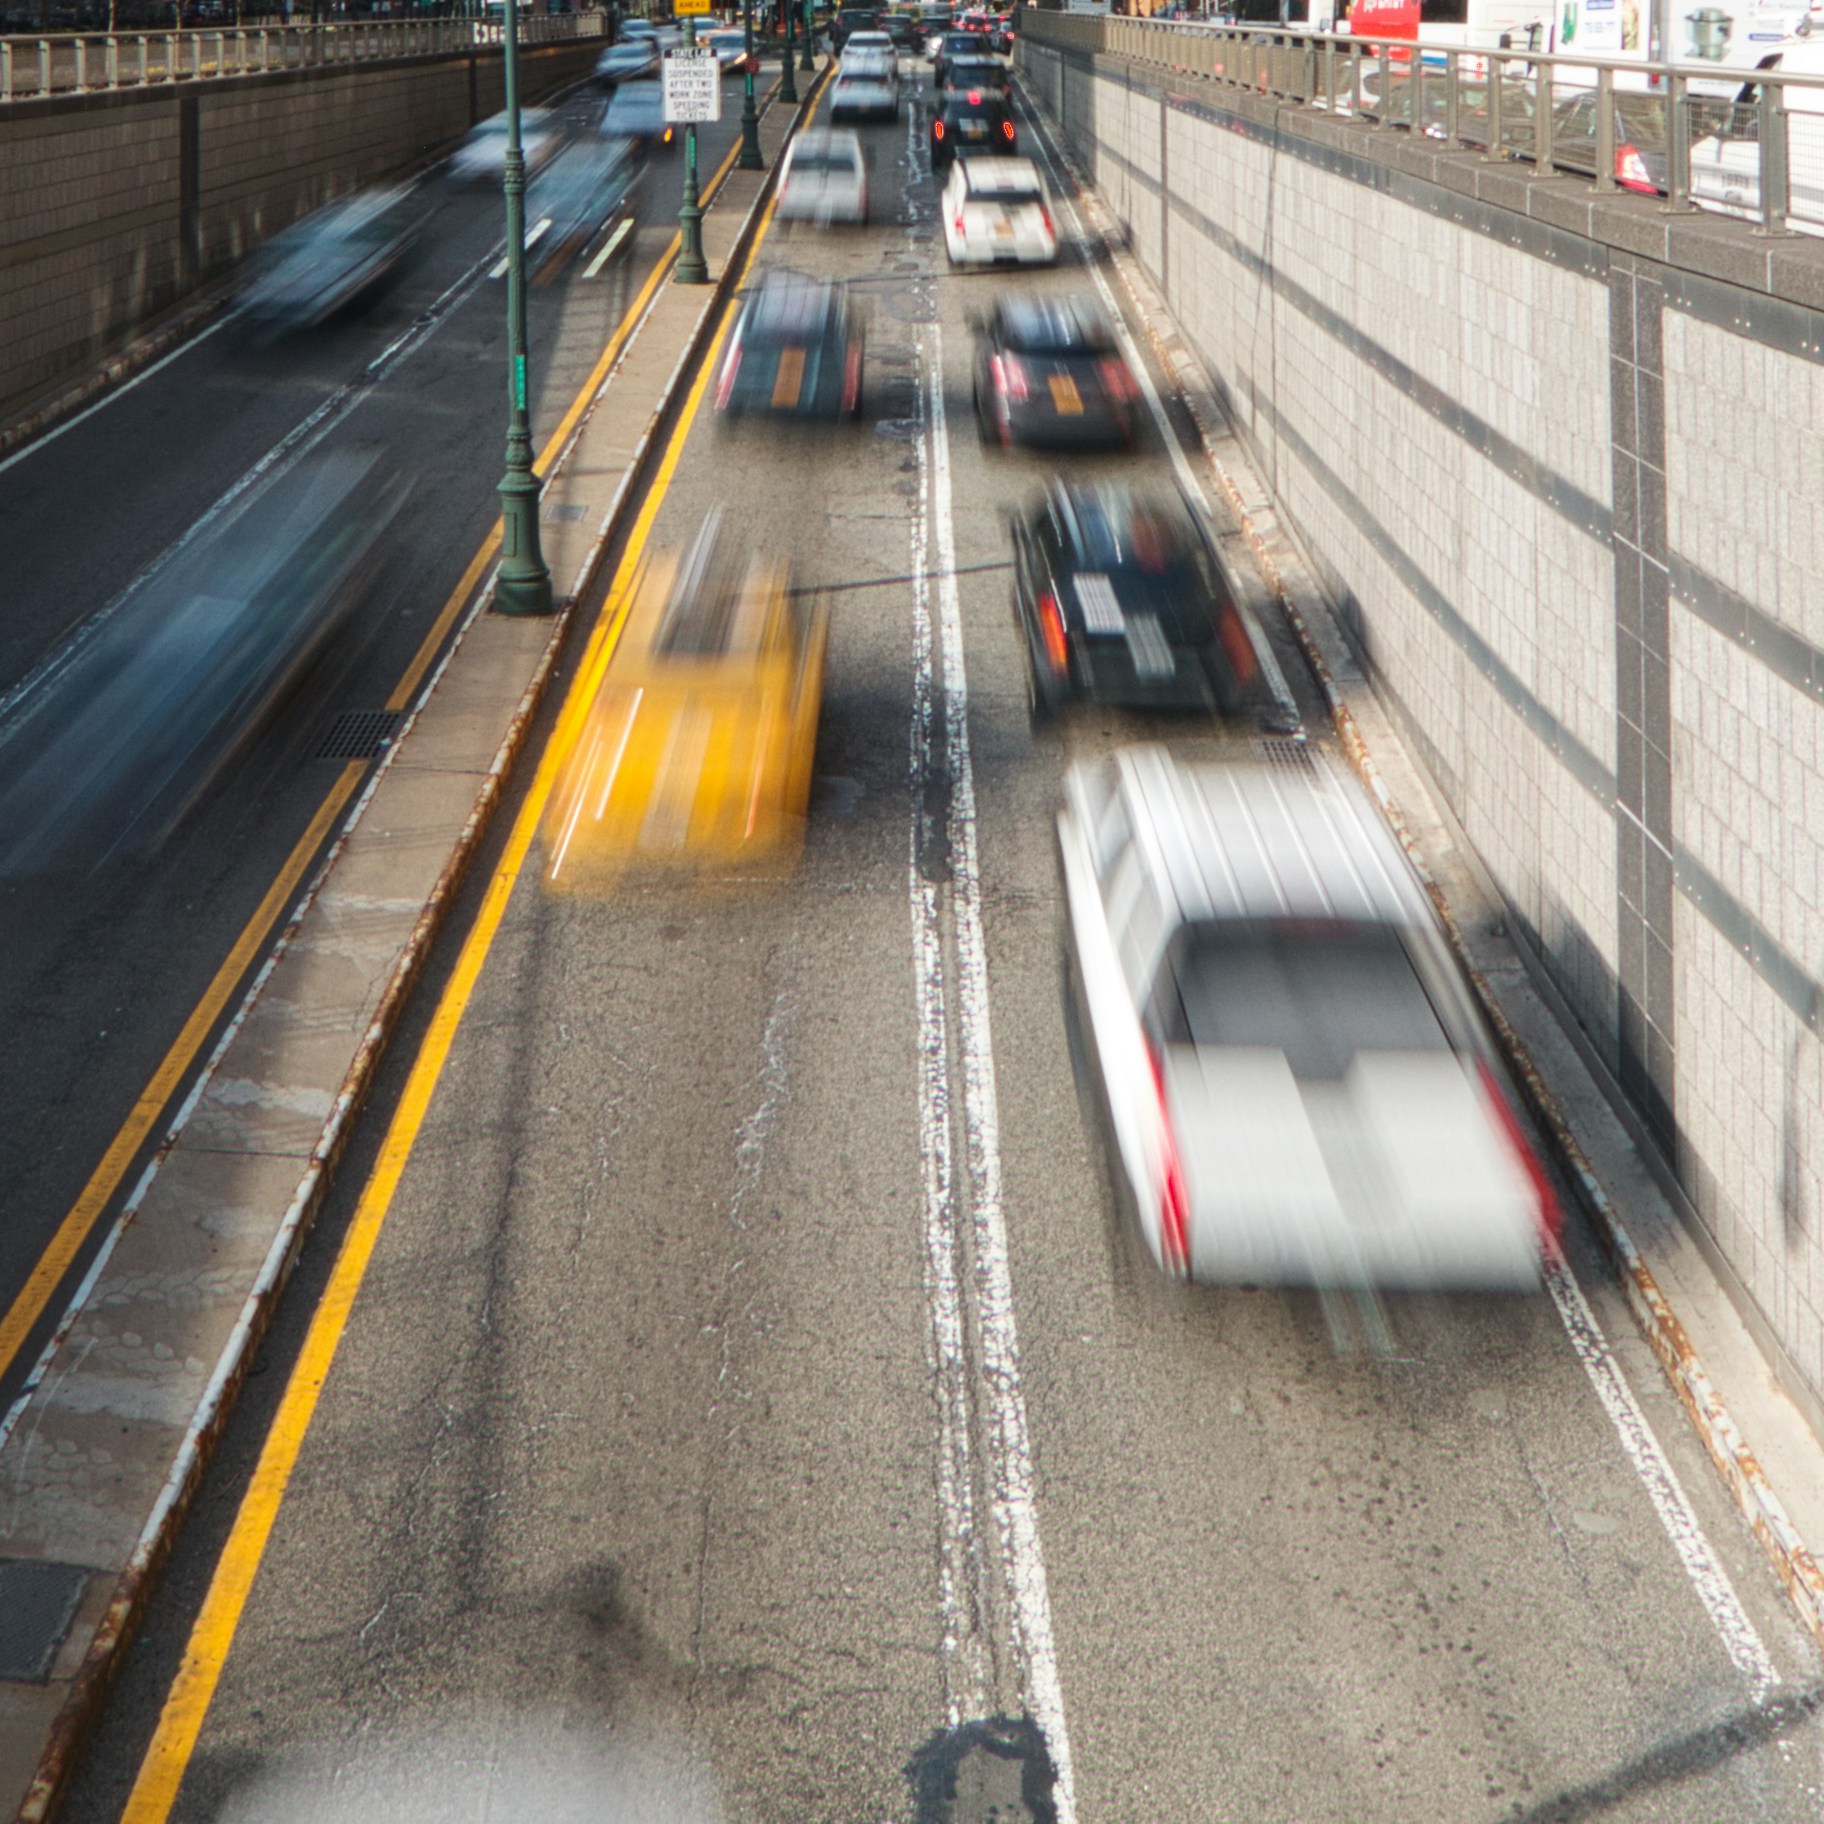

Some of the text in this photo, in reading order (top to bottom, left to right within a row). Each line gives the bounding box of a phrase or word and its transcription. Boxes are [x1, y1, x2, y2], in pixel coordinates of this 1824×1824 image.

[675, 58, 706, 67] LICENSE
[670, 80, 712, 88] AFTER TWO
[669, 90, 713, 99] WORK ZONE
[673, 101, 710, 109] SPEEDING
[676, 111, 708, 120] TICKETS
